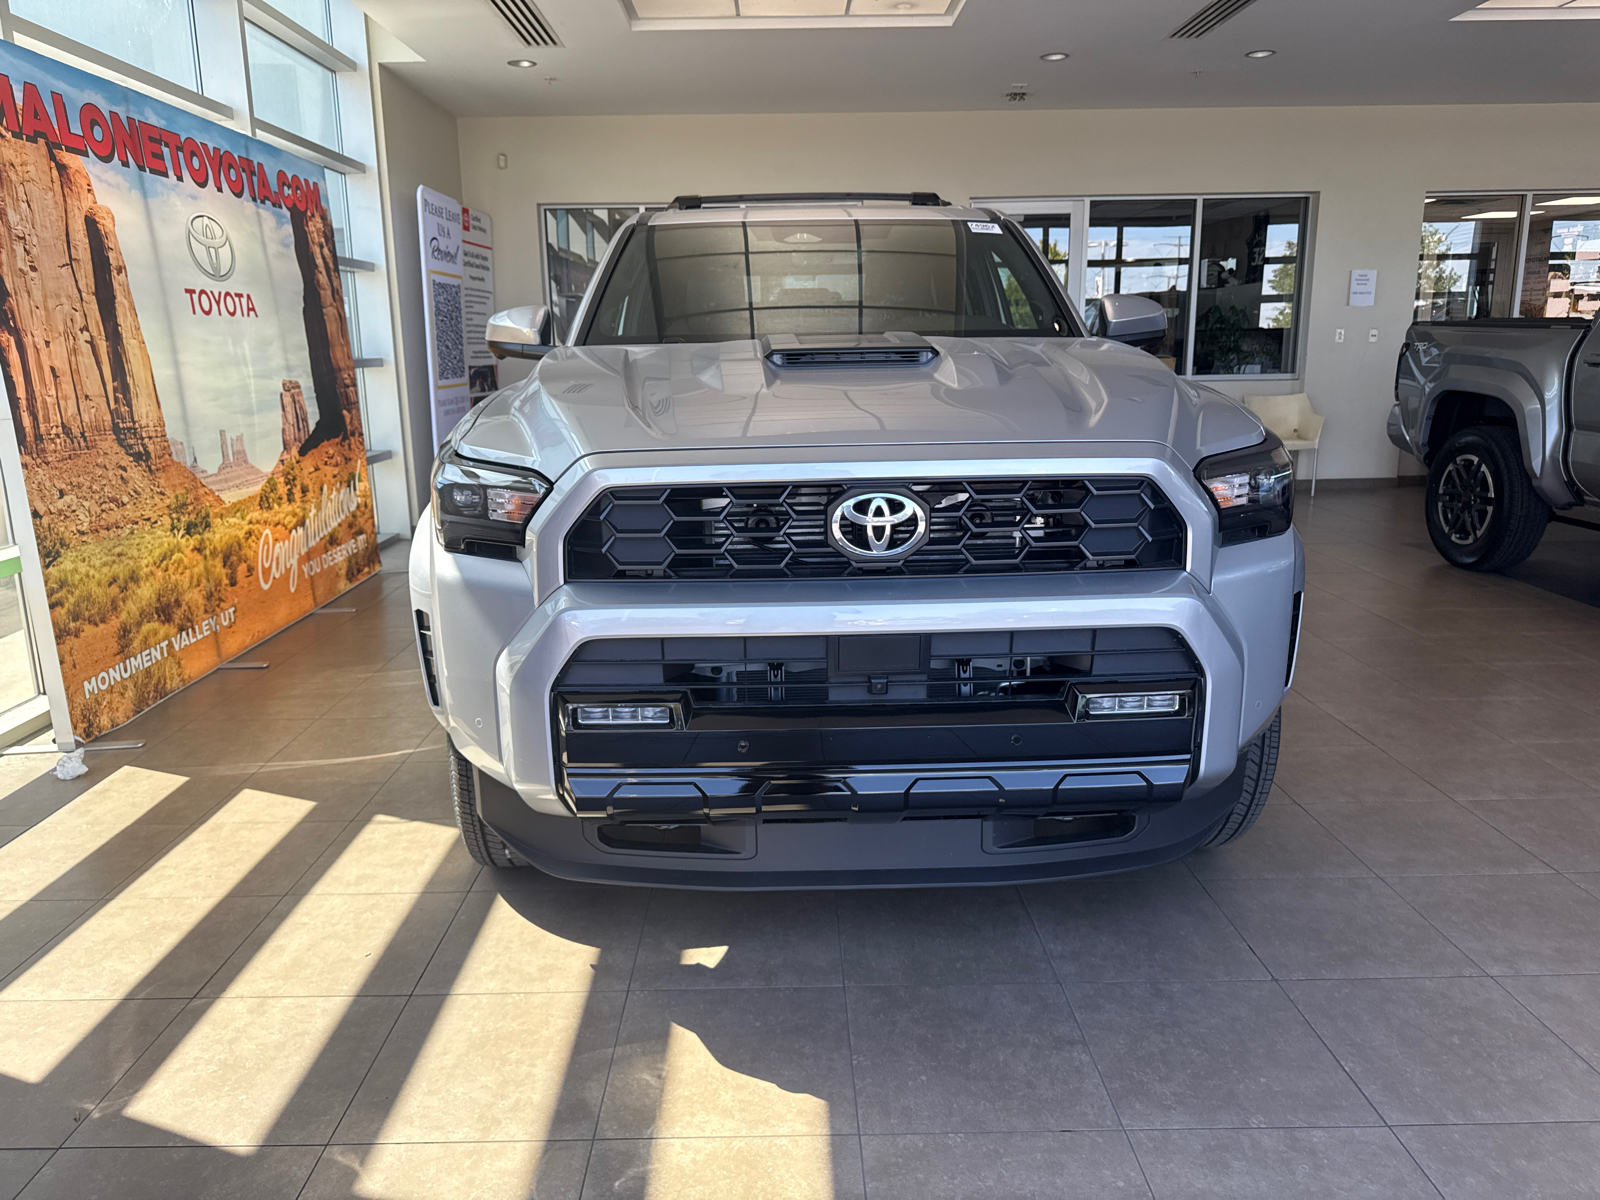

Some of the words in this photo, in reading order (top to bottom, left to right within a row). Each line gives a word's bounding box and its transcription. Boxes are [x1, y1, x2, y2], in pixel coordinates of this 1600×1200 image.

[185, 288, 259, 318] TOYOTA
[258, 458, 361, 594] Congratulations!
[301, 557, 321, 579] YOU
[321, 538, 358, 569] DESERVE
[83, 640, 169, 699] MONUMENT
[171, 615, 220, 652] VALLEY,
[220, 606, 236, 627] UT
